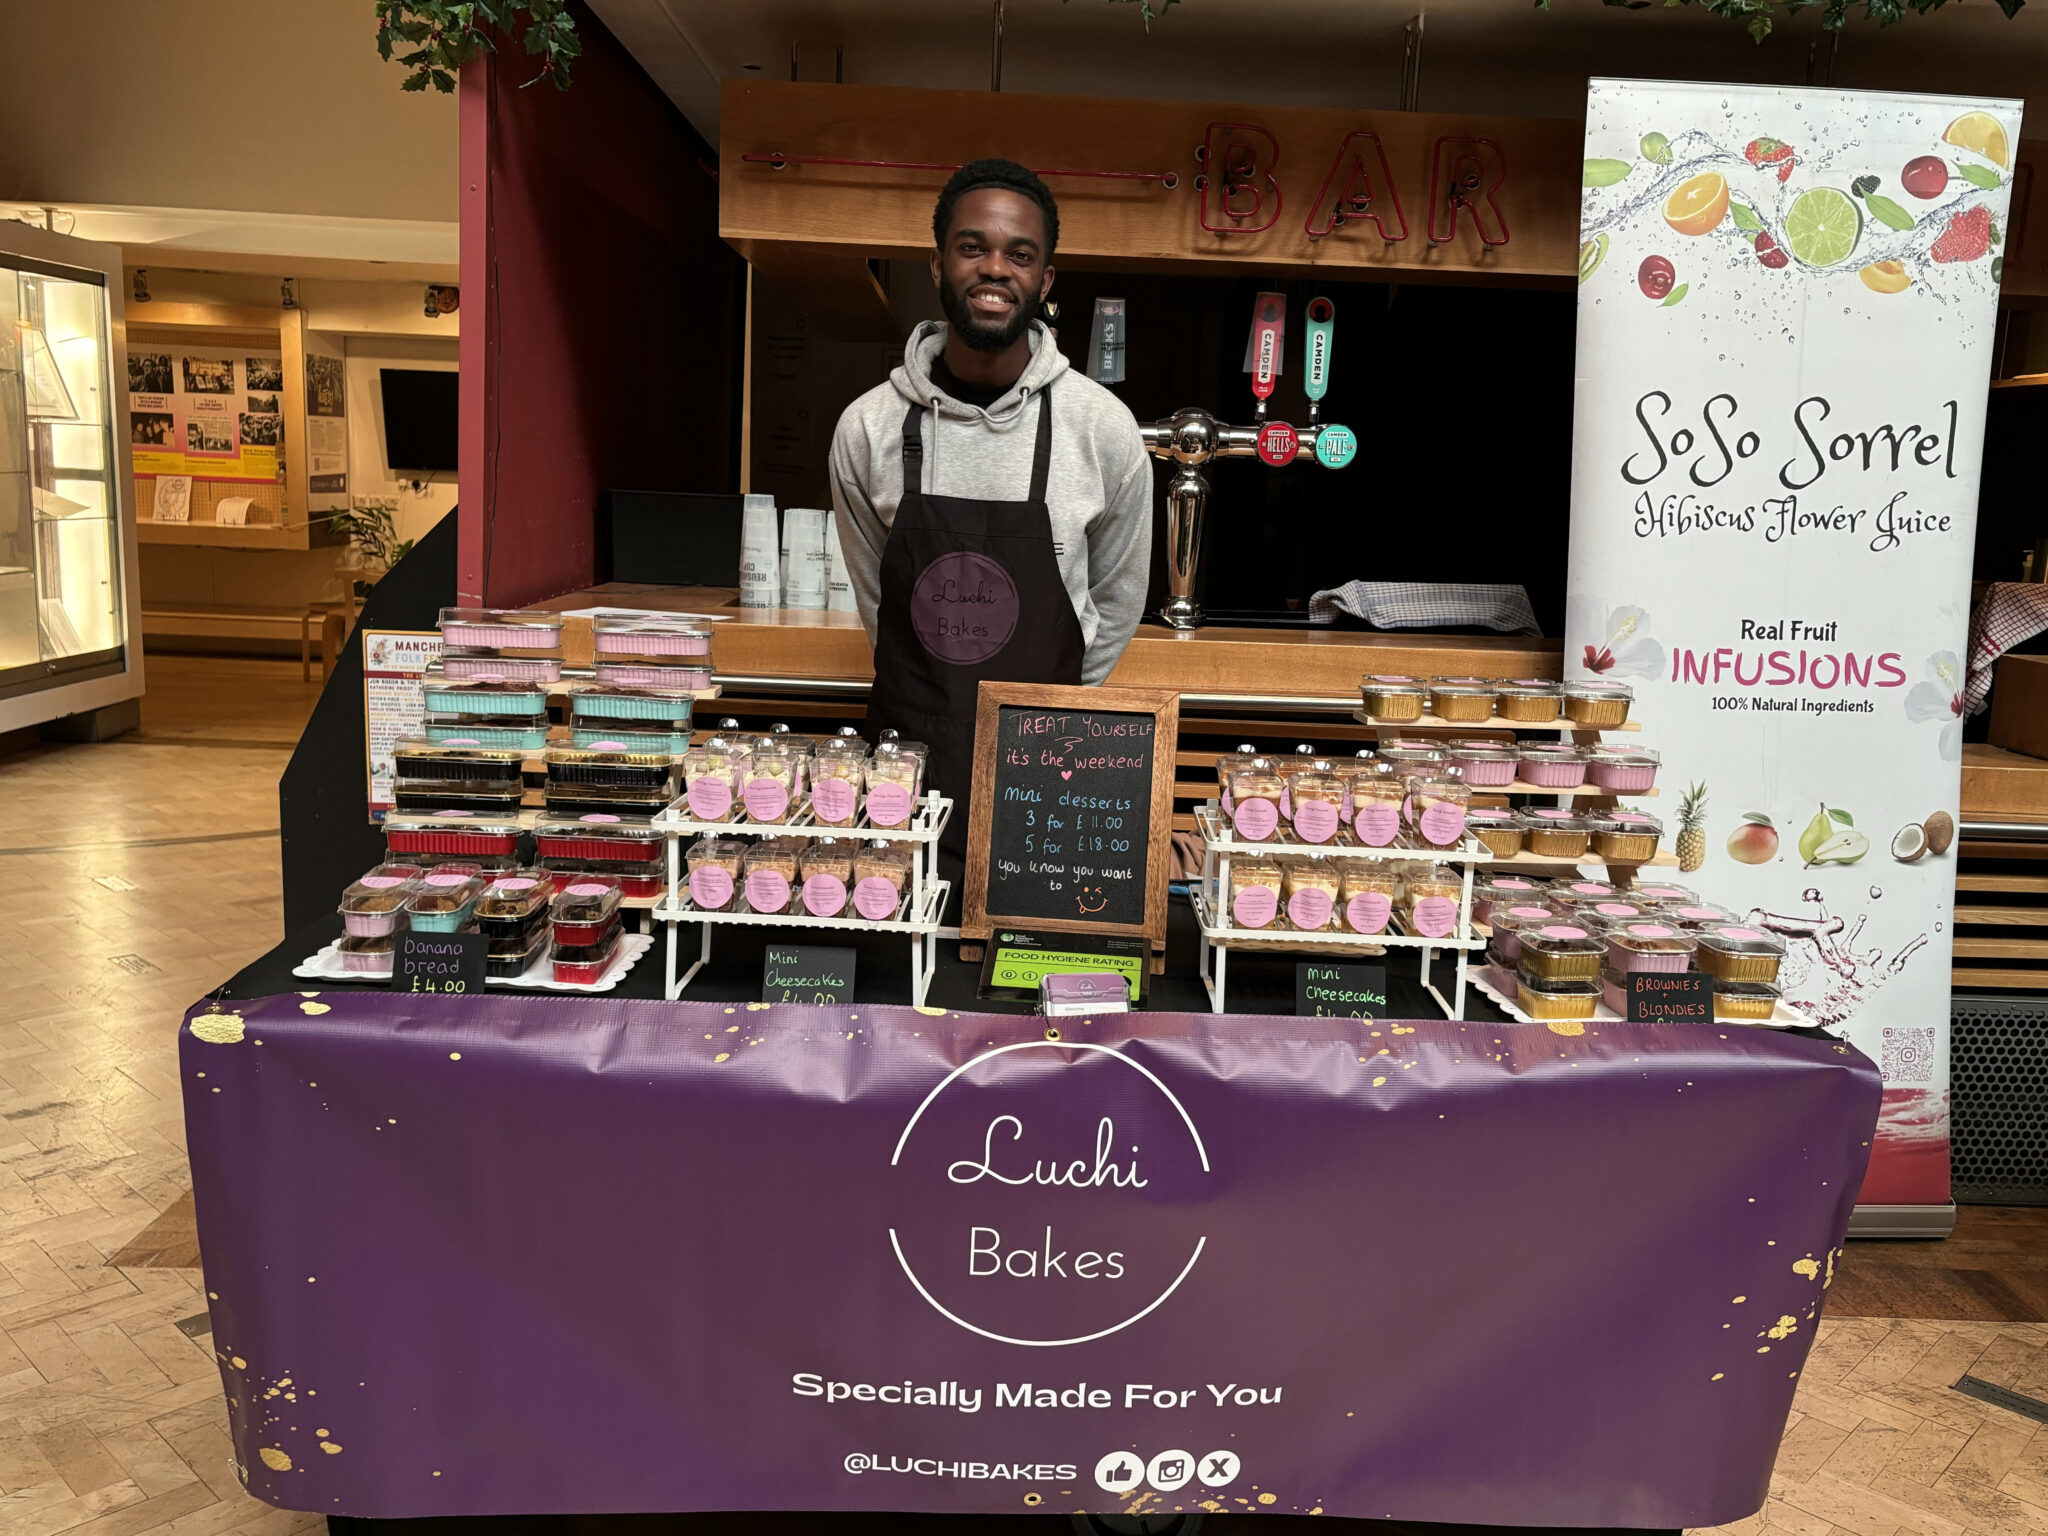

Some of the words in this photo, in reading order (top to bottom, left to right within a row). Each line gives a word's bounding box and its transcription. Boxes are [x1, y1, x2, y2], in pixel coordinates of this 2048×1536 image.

[1200, 122, 1510, 246] BAR
[1260, 333, 1272, 380] CAMDEN
[1313, 334, 1324, 380] CAMDEN
[1267, 437, 1290, 453] HELLS
[1325, 439, 1348, 456] PALE
[1620, 390, 1761, 488] SoSo
[1778, 396, 1958, 490] Sorrel
[1633, 490, 1756, 538] Hibiscus
[1761, 495, 1867, 542] Flower
[1869, 491, 1951, 552] Juice
[931, 579, 998, 605] Luchi
[938, 617, 989, 637] Bakes
[1740, 619, 1784, 641] Real
[1790, 620, 1838, 642] Fruit
[395, 653, 421, 663] FOLK
[1671, 647, 1907, 690] INFUSIONS
[1711, 697, 1749, 711] 100%
[1751, 697, 1798, 712] Natural
[1801, 698, 1875, 716] Ingredients
[1008, 710, 1071, 737] TREAT
[1082, 715, 1153, 737] YOURSELF
[1006, 747, 1030, 766] it's
[1040, 750, 1065, 767] the
[1074, 753, 1144, 769] weekend
[1058, 790, 1131, 811] desserts
[1026, 809, 1035, 827] 3
[1047, 813, 1065, 832] for
[1025, 834, 1034, 853] 5
[1043, 839, 1062, 856] for
[1078, 836, 1130, 852] £18.00
[998, 858, 1021, 881] you
[1029, 860, 1065, 874] know
[1073, 865, 1094, 884] you
[1101, 867, 1133, 880] want
[1049, 880, 1063, 891] to
[404, 936, 463, 955] banana
[404, 957, 459, 975] bread
[769, 949, 799, 965] Mini
[1004, 952, 1039, 960] FOOD
[1042, 954, 1090, 964] HYGIENE
[1093, 956, 1134, 967] RATING
[411, 975, 466, 995] £4.00
[765, 967, 845, 987] Cheesecakes
[1636, 977, 1700, 993] BROWNIES
[1639, 1001, 1705, 1018] BLONDIES
[947, 1114, 1149, 1188] Luchi
[969, 1225, 1126, 1279] Bakes
[791, 1372, 983, 1413] Specially
[995, 1382, 1112, 1409] Made
[1124, 1383, 1197, 1409] For
[1205, 1382, 1283, 1407] You
[843, 1451, 1078, 1482] @LUCHIBAKES
